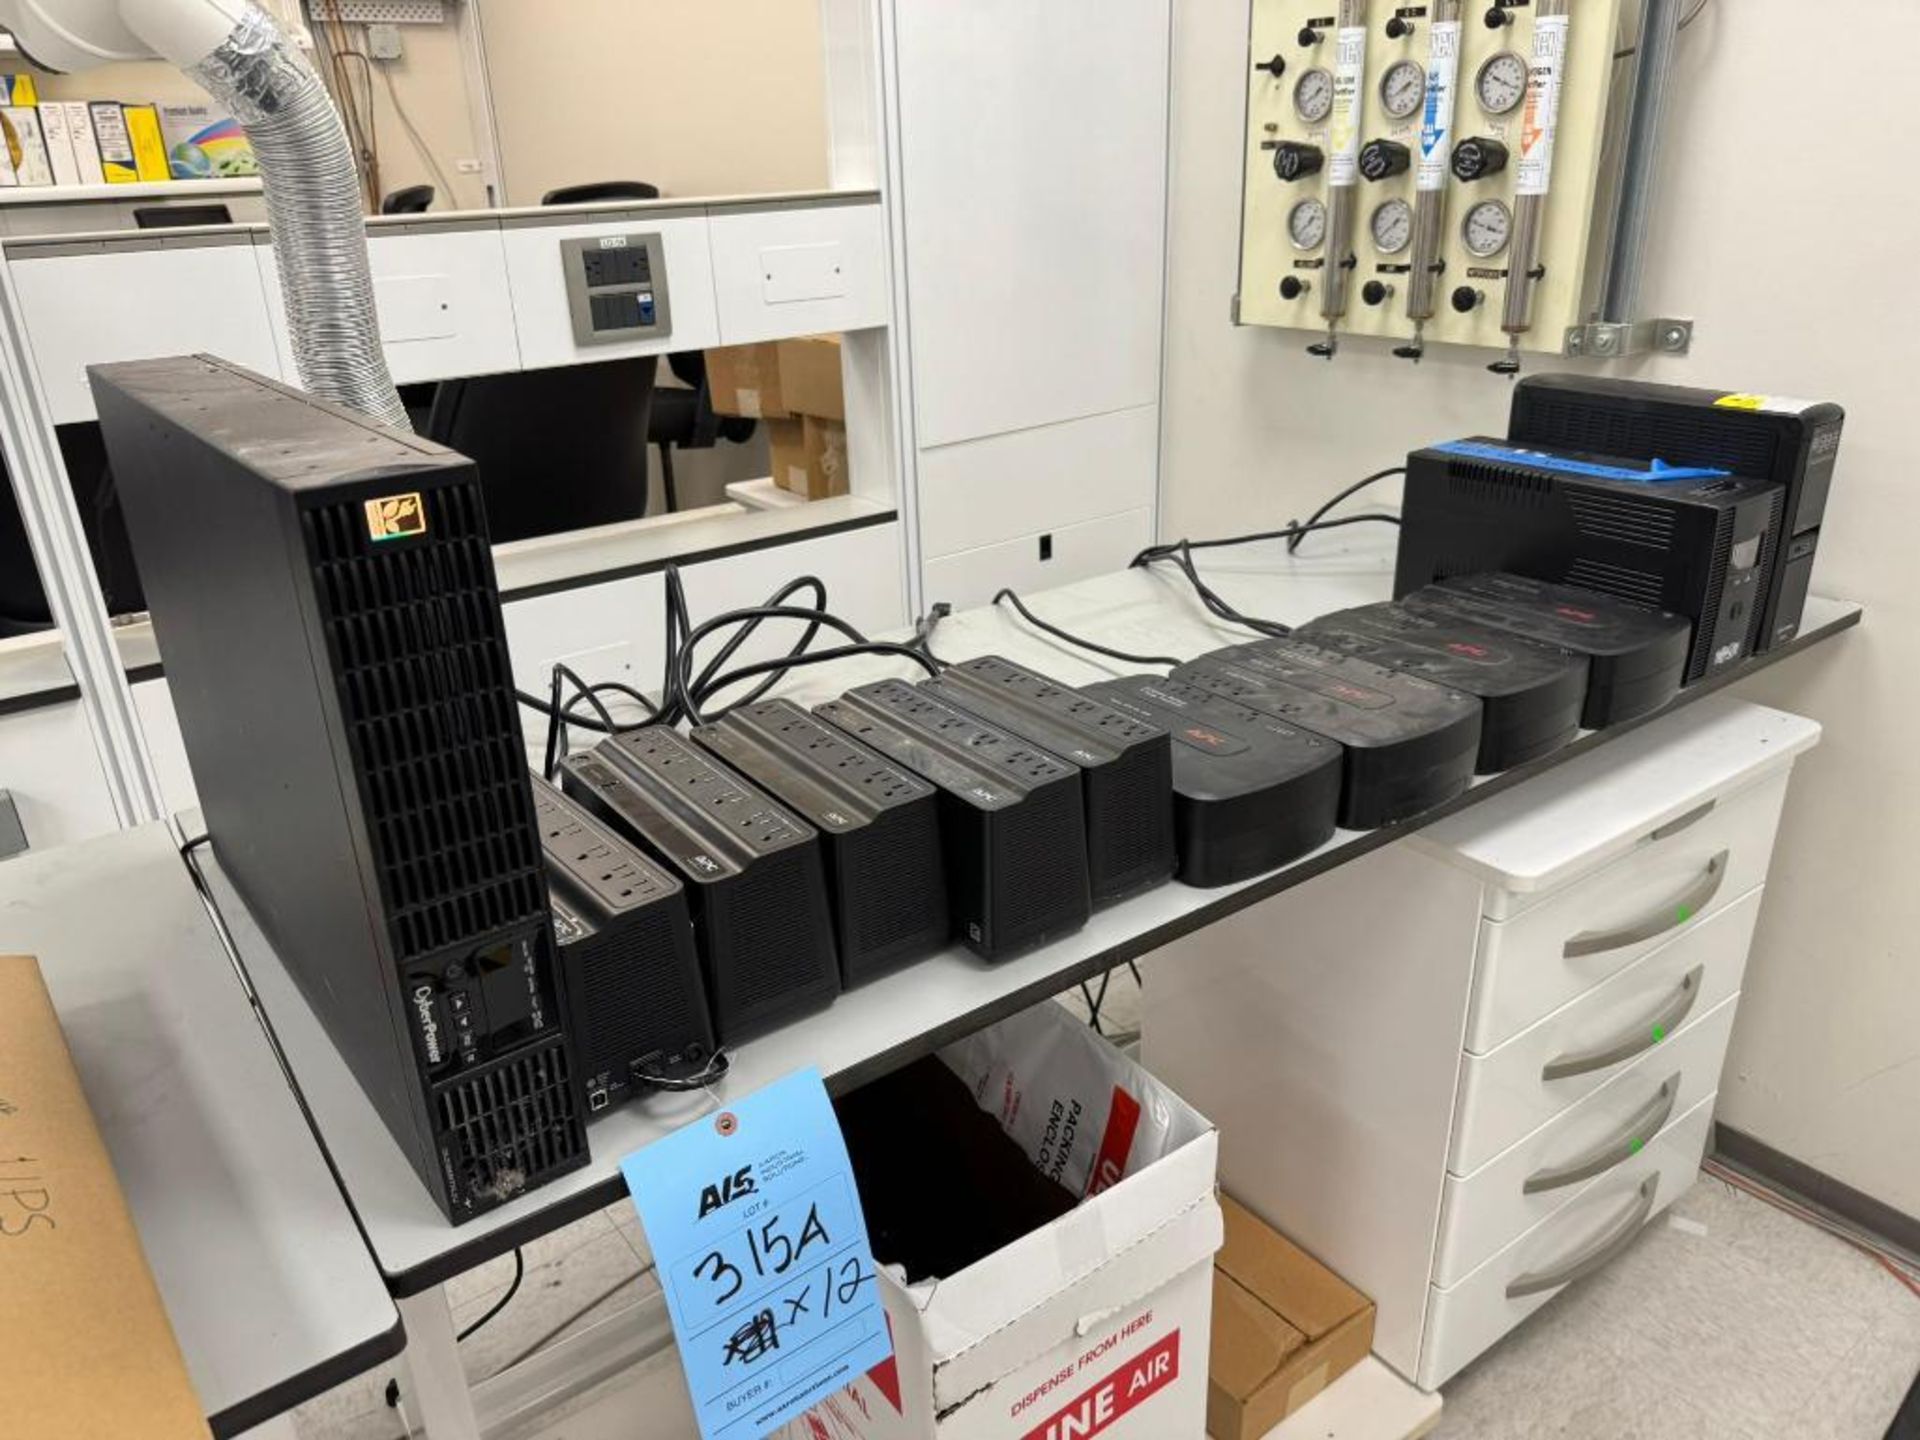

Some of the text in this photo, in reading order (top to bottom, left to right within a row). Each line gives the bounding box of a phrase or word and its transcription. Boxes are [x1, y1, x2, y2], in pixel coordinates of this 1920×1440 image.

[413, 986, 441, 1063] CyberPower
[1036, 1099, 1064, 1174] ENCLOS
[1050, 1099, 1082, 1183] PACKING
[698, 1163, 759, 1220] AIS
[743, 1203, 761, 1218] LOT
[693, 1202, 829, 1305] 315A
[726, 1385, 761, 1411] BUYER
[1011, 1309, 1153, 1417] DISPENSE FROM HERE
[1127, 1350, 1170, 1398] AIR
